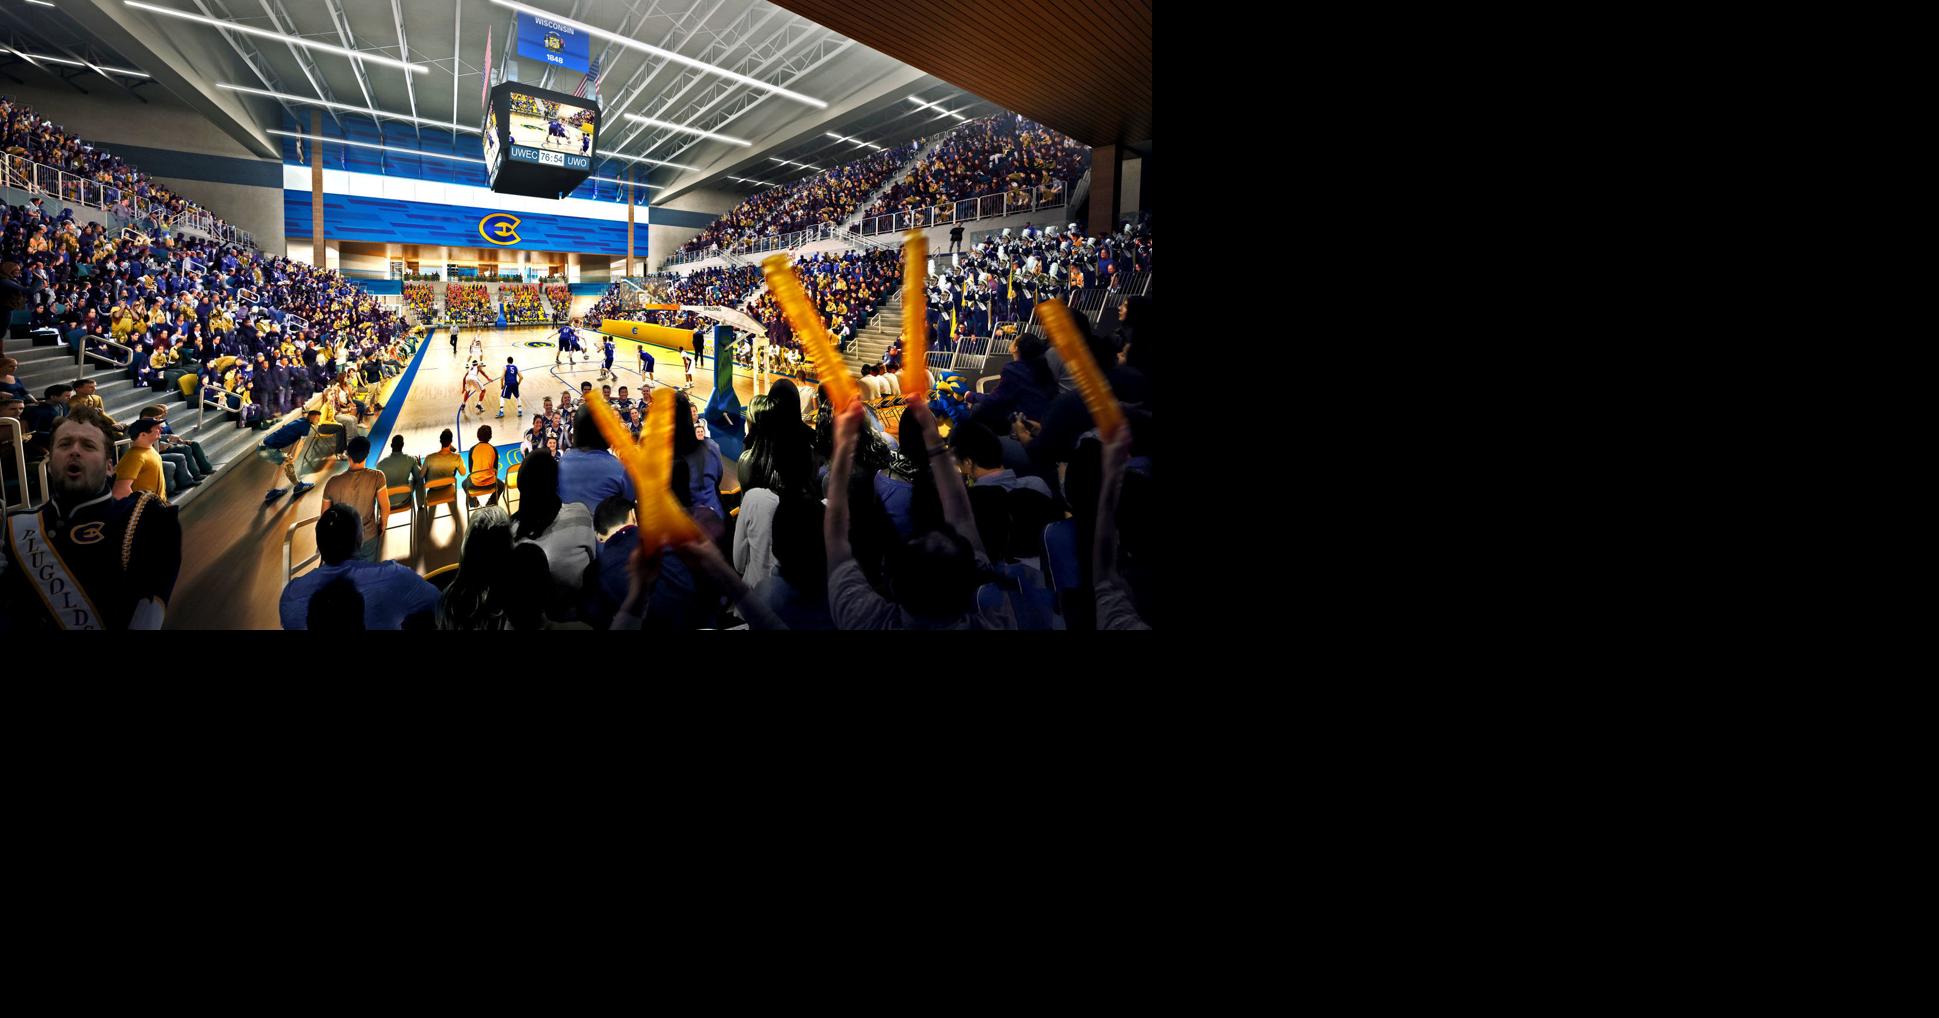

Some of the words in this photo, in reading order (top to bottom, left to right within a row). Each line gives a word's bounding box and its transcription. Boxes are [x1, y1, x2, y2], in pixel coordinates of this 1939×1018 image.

[535, 15, 575, 35] WISCONSIN
[546, 53, 564, 64] 1848
[511, 147, 538, 160] UWEC
[567, 156, 587, 168] UWO
[510, 366, 515, 374] 5
